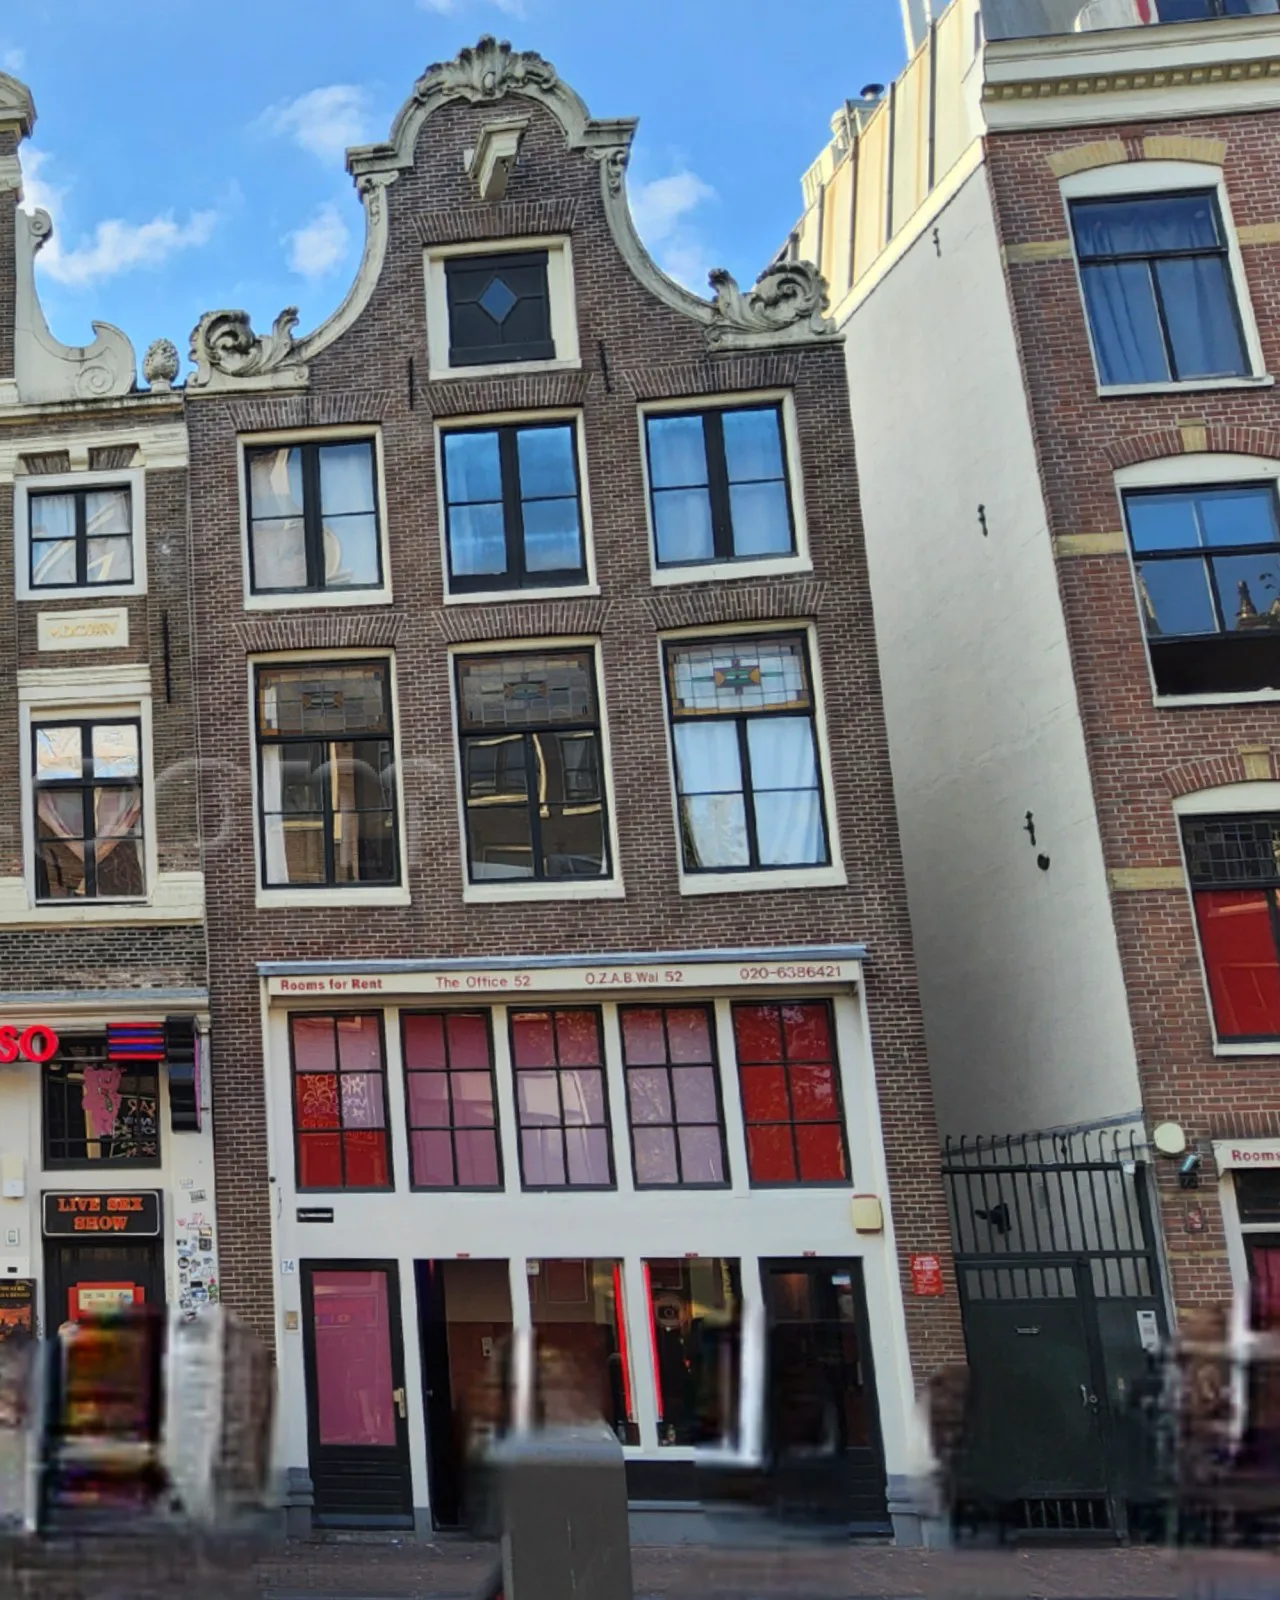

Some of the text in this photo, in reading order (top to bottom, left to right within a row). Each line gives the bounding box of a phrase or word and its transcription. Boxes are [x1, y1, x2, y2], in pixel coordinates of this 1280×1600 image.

[435, 975, 531, 988] The Office 52
[665, 970, 684, 983] 52
[280, 978, 382, 991] Rooms for Rent
[57, 1197, 143, 1212] LIVE SEX
[73, 1216, 128, 1230] SHOW
